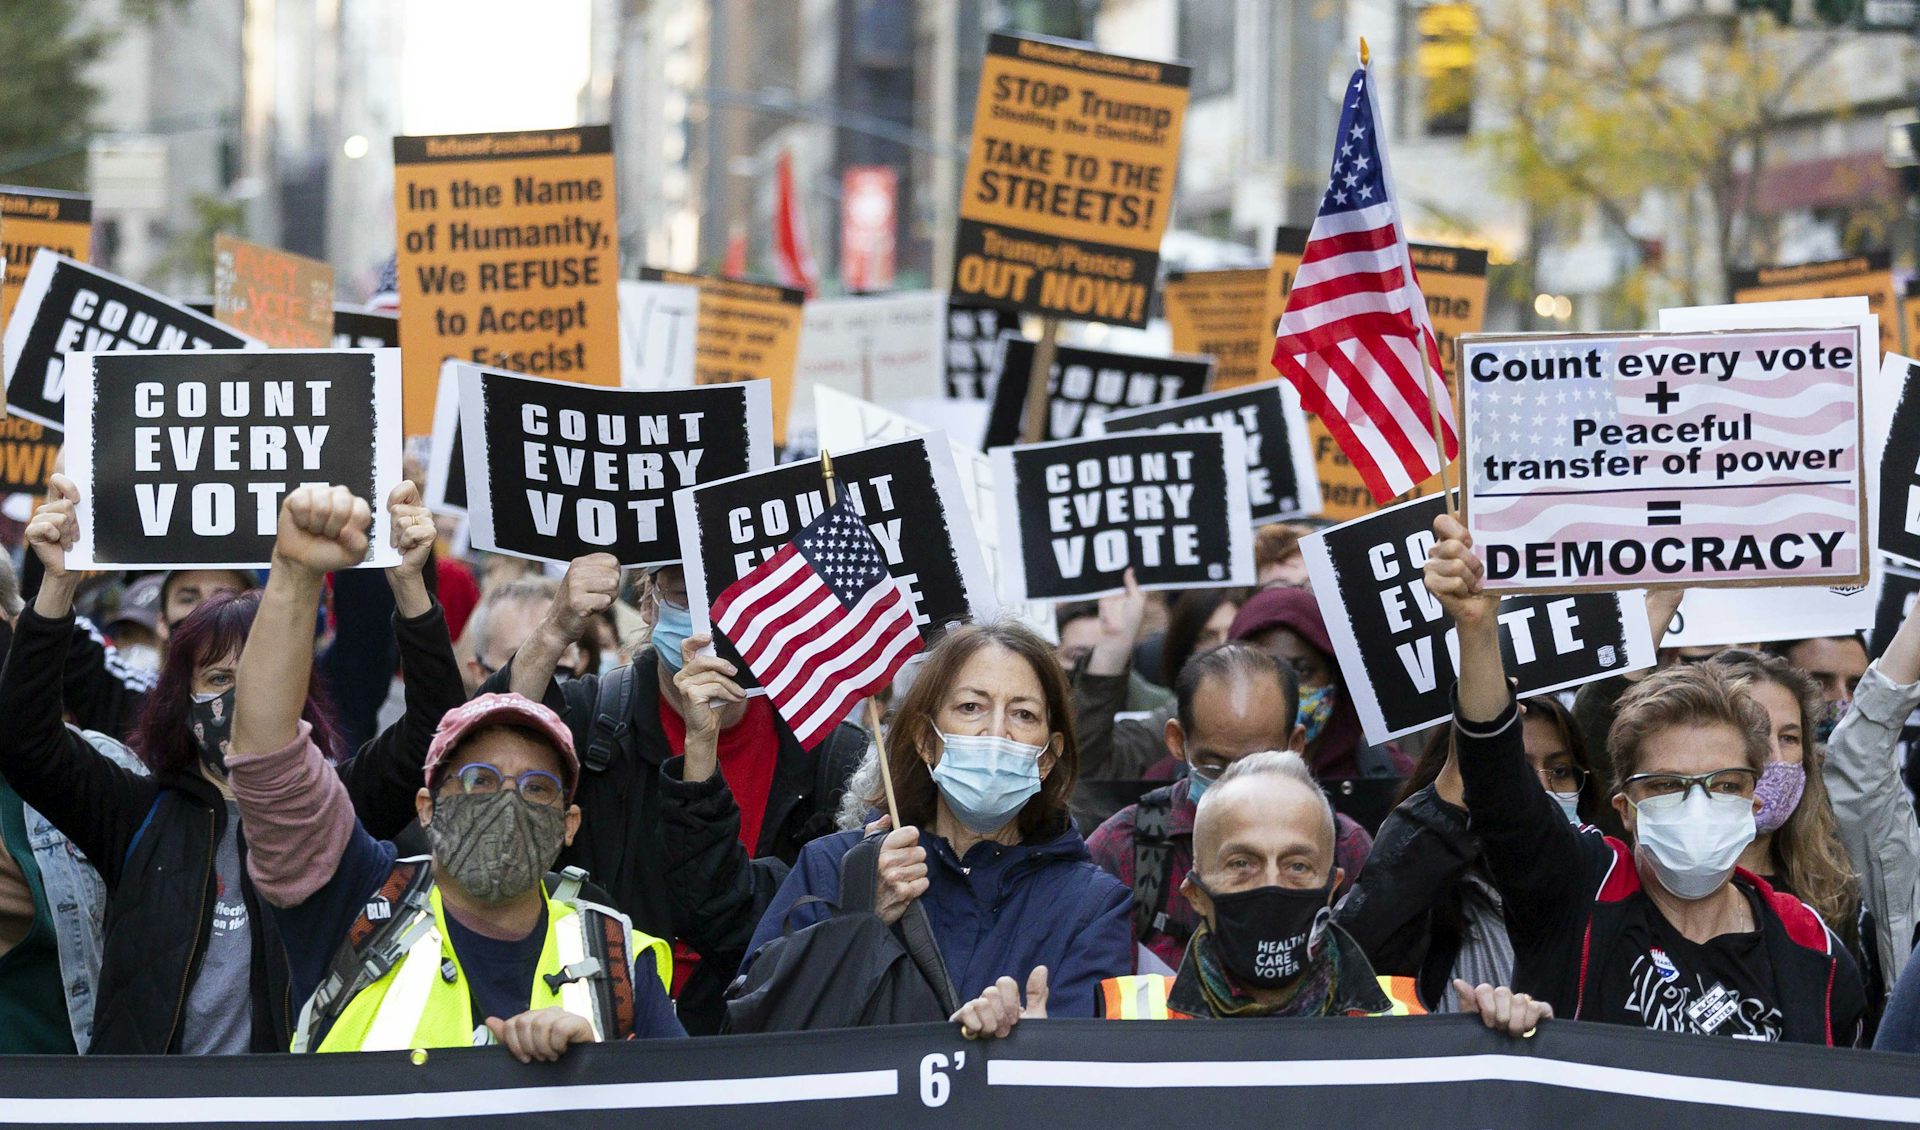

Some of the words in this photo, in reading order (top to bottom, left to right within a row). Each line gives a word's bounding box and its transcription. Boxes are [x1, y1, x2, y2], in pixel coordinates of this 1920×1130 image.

[993, 73, 1069, 107] STOP
[1080, 89, 1171, 130] Trump
[1064, 118, 1088, 134] the
[982, 137, 1053, 174] TAKE
[1064, 152, 1099, 182] TO
[1109, 159, 1163, 192] THE
[407, 181, 437, 211] In
[451, 178, 502, 208] the
[514, 174, 604, 206] Name
[976, 169, 1157, 231] STREETS!
[405, 222, 437, 253] of
[450, 215, 611, 250] Humanity,
[417, 261, 467, 295] We
[479, 255, 601, 292] REFUSE
[957, 252, 1037, 304] OUT
[1039, 269, 1147, 323] NOW!
[436, 308, 467, 337] to
[477, 300, 587, 336] Accept
[1424, 296, 1471, 317] me
[471, 341, 587, 373] Fascist
[1470, 349, 1602, 383] Count
[1618, 350, 1741, 382] every
[1756, 340, 1854, 372] vote
[134, 380, 332, 419] COUNT
[521, 403, 705, 446] COUNT
[1573, 413, 1753, 447] Peaceful
[134, 425, 331, 472] EVERY
[523, 440, 705, 492] EVERY
[1484, 450, 1648, 482] transfer
[1662, 446, 1703, 475] of
[1716, 447, 1844, 481] power
[1045, 450, 1196, 494] COUNT
[134, 481, 330, 537] VOT
[525, 488, 666, 546] VOT
[1048, 483, 1196, 533] EVERY
[1051, 524, 1201, 580] VOTE
[1485, 530, 1846, 581] DEMOCRACY
[1395, 596, 1585, 695] VTE
[212, 918, 227, 930] on
[366, 900, 392, 921] BLM
[1255, 951, 1292, 968] CARE
[1257, 932, 1307, 954] HEALTH
[1254, 960, 1300, 979] VOTER
[1707, 1004, 1734, 1029] MATTER
